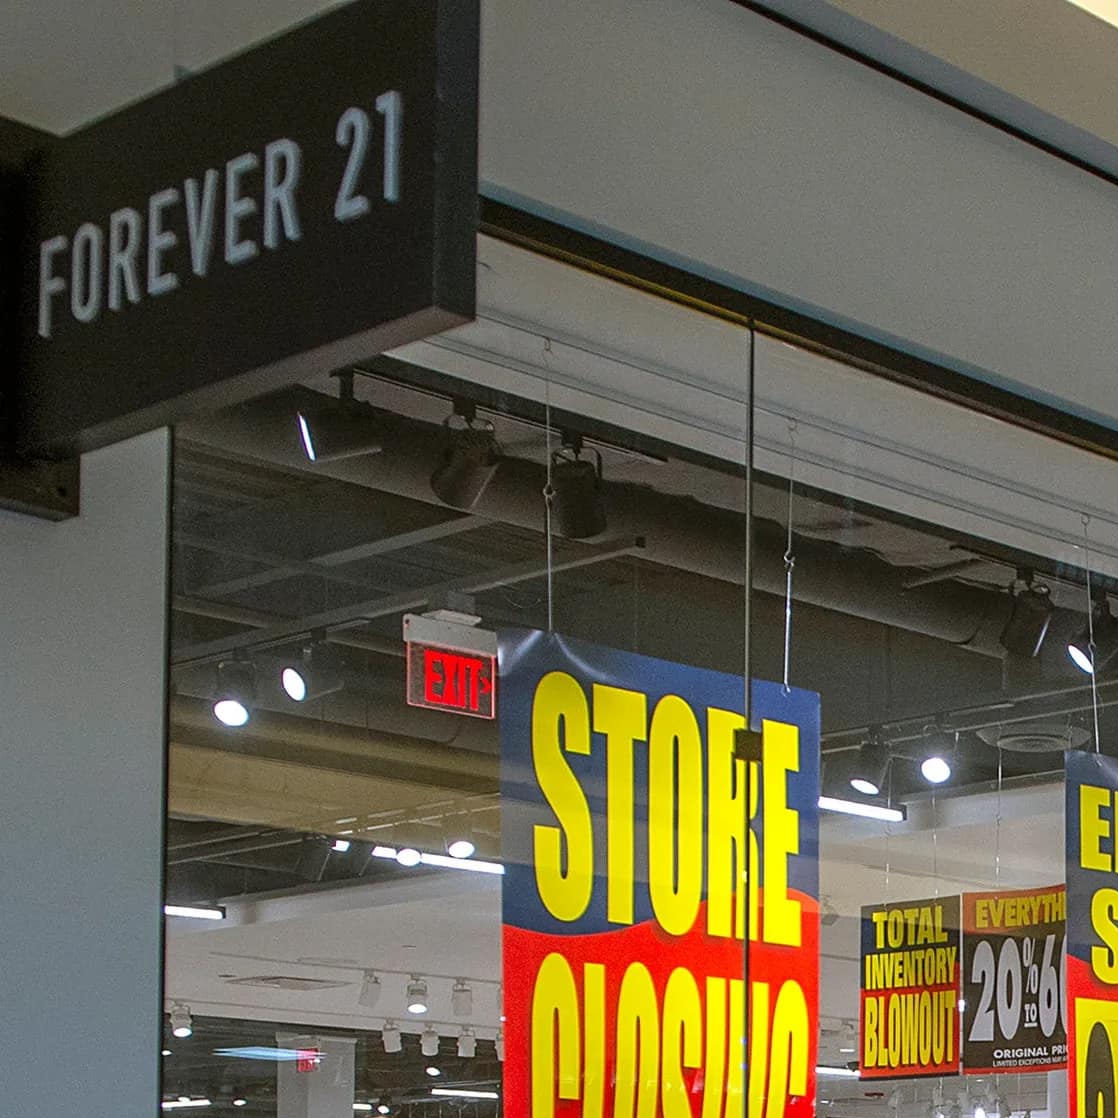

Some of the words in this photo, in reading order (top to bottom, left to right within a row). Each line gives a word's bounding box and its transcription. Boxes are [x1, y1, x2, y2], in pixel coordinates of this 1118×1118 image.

[37, 138, 302, 338] FOREVER
[334, 90, 402, 221] 21
[424, 648, 484, 711] EXIT
[532, 670, 801, 948] STORE
[872, 905, 948, 950] TOTAL
[975, 891, 1066, 929] EVERYTH
[865, 946, 957, 990] INVENTORY
[1039, 934, 1067, 1038] 6
[864, 989, 956, 1068] BLOWOUT
[993, 1046, 1049, 1059] ORIGINAL
[1051, 1044, 1067, 1055] PRI
